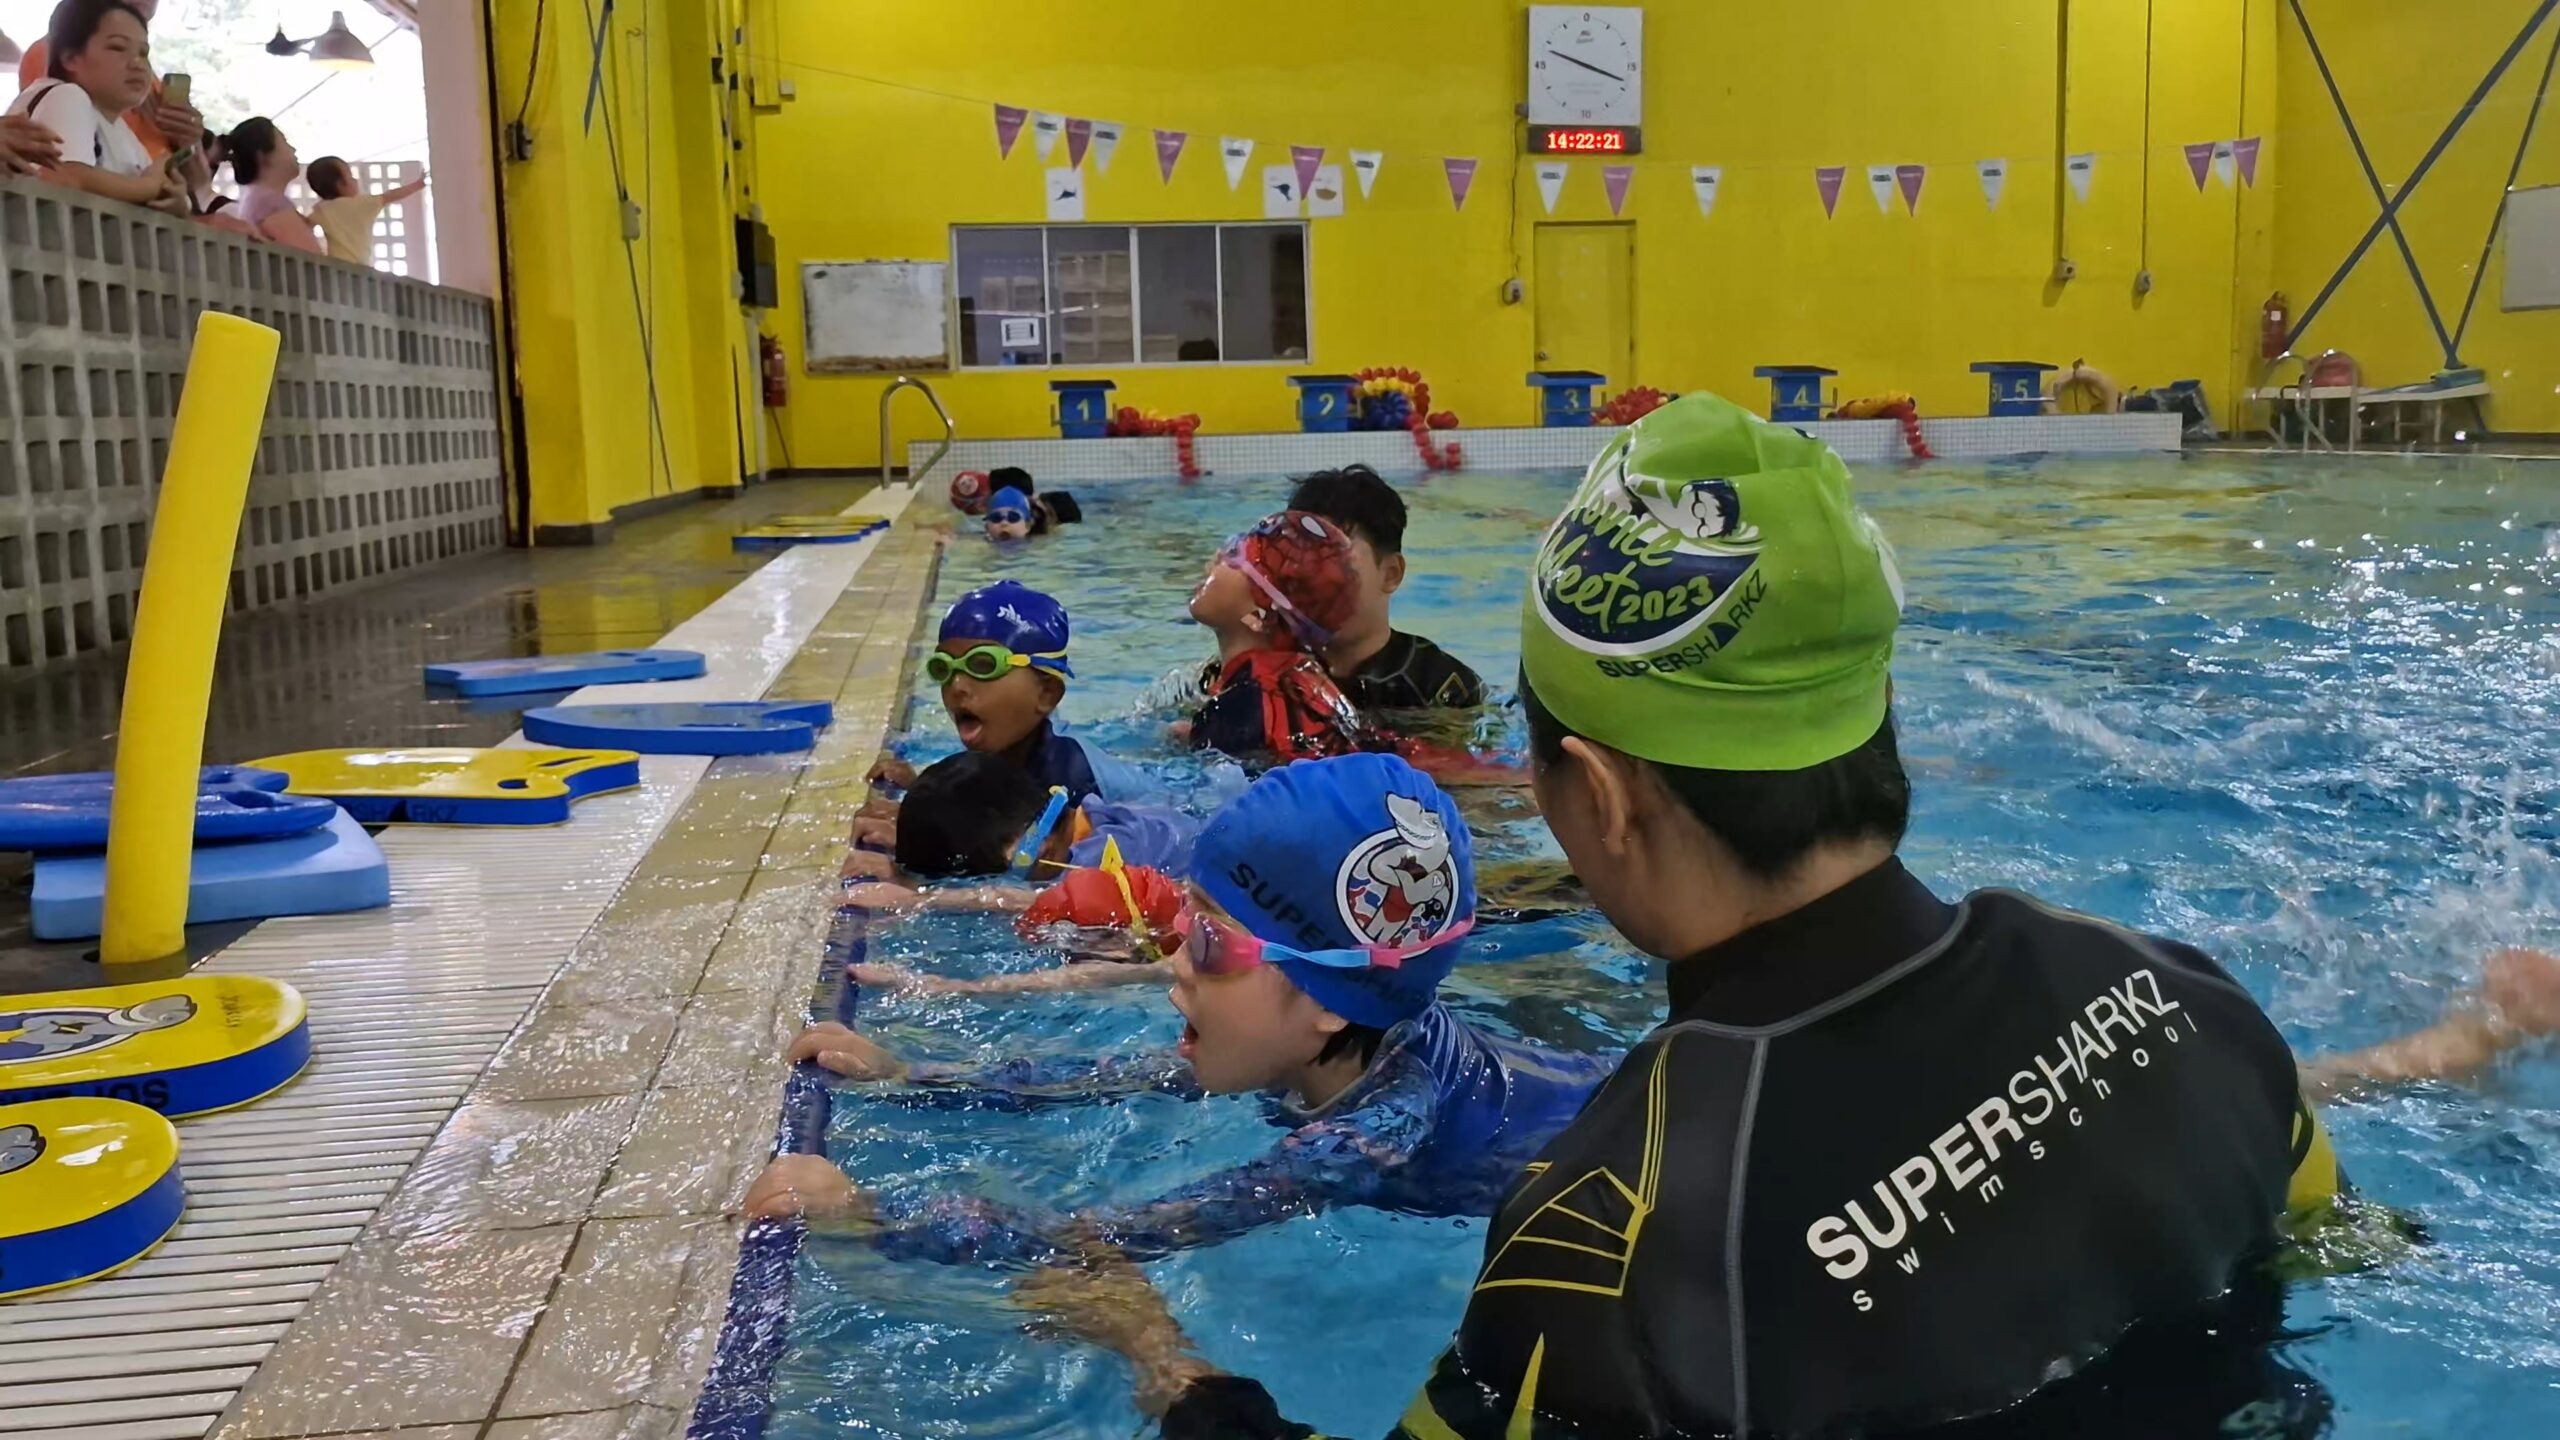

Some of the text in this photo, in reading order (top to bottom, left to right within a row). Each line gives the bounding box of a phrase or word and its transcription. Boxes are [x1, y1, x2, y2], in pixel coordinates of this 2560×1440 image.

[1534, 61, 1546, 70] 45
[1548, 132, 1621, 149] 14:22:21
[1564, 388, 1579, 415] 3
[1793, 384, 1809, 411] 4
[2015, 378, 2029, 404] 5
[1076, 398, 1089, 421] 1
[1318, 393, 1335, 416] 2
[1616, 575, 1714, 624] 2023
